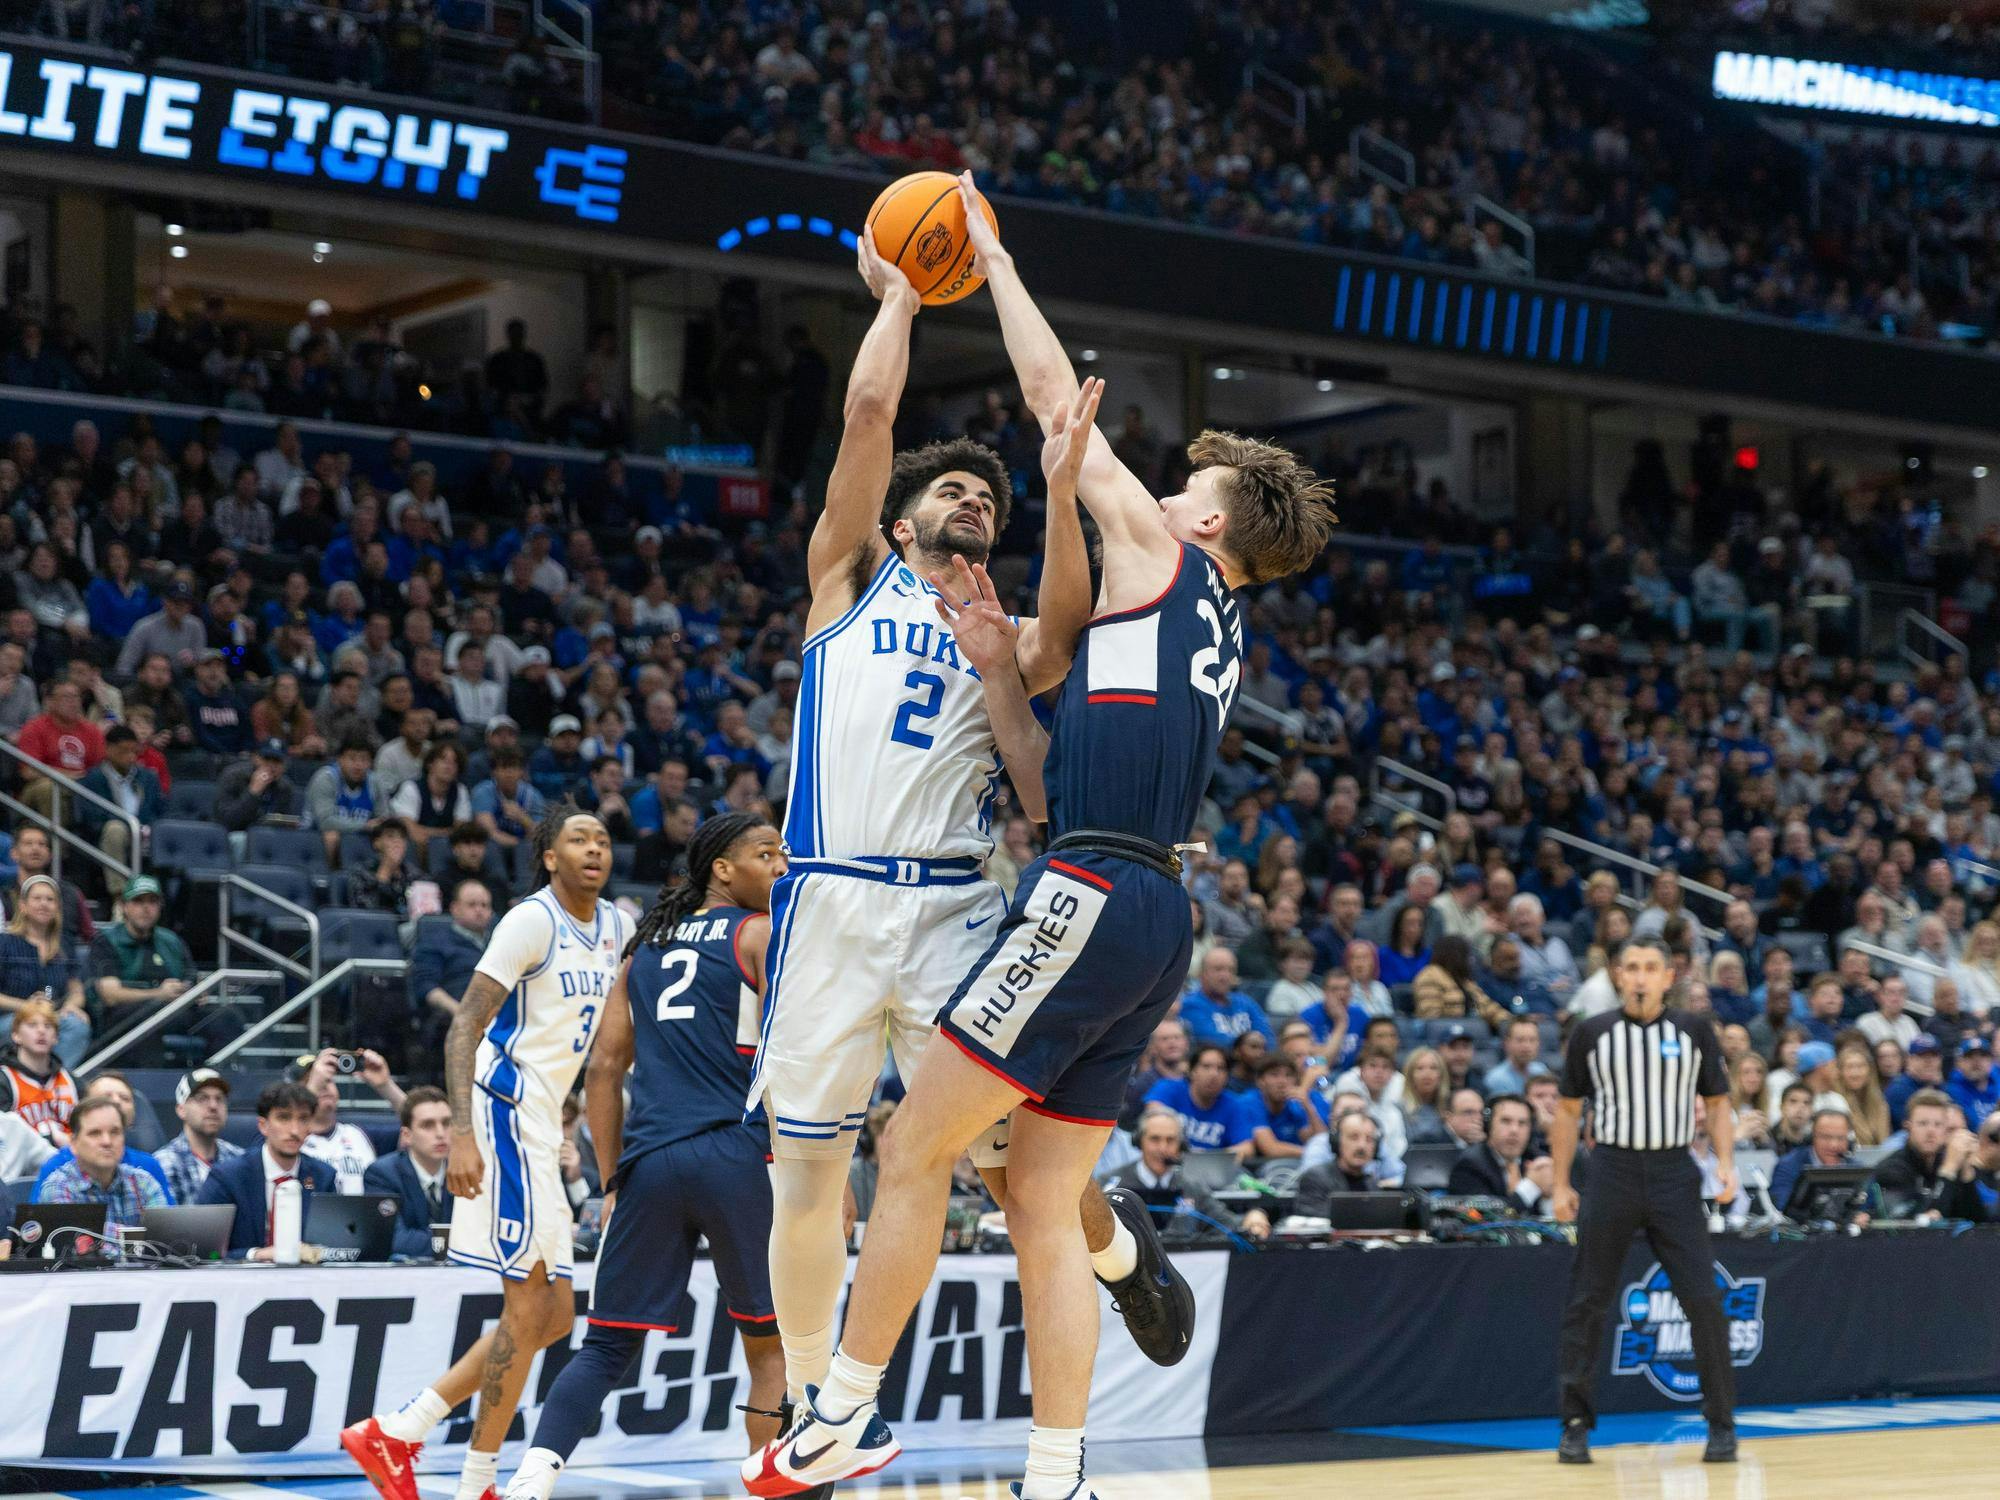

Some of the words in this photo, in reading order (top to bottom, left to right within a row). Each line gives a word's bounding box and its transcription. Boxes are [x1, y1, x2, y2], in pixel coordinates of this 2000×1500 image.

[218, 89, 509, 200] EIGHT
[872, 618, 983, 683] DUK
[891, 670, 946, 750] 2
[895, 861, 920, 883] D
[559, 970, 615, 998] DUK
[657, 948, 700, 1022] 2
[972, 891, 1079, 1038] HUSKIES
[573, 1005, 596, 1054] 3
[41, 1297, 415, 1459] EAST
